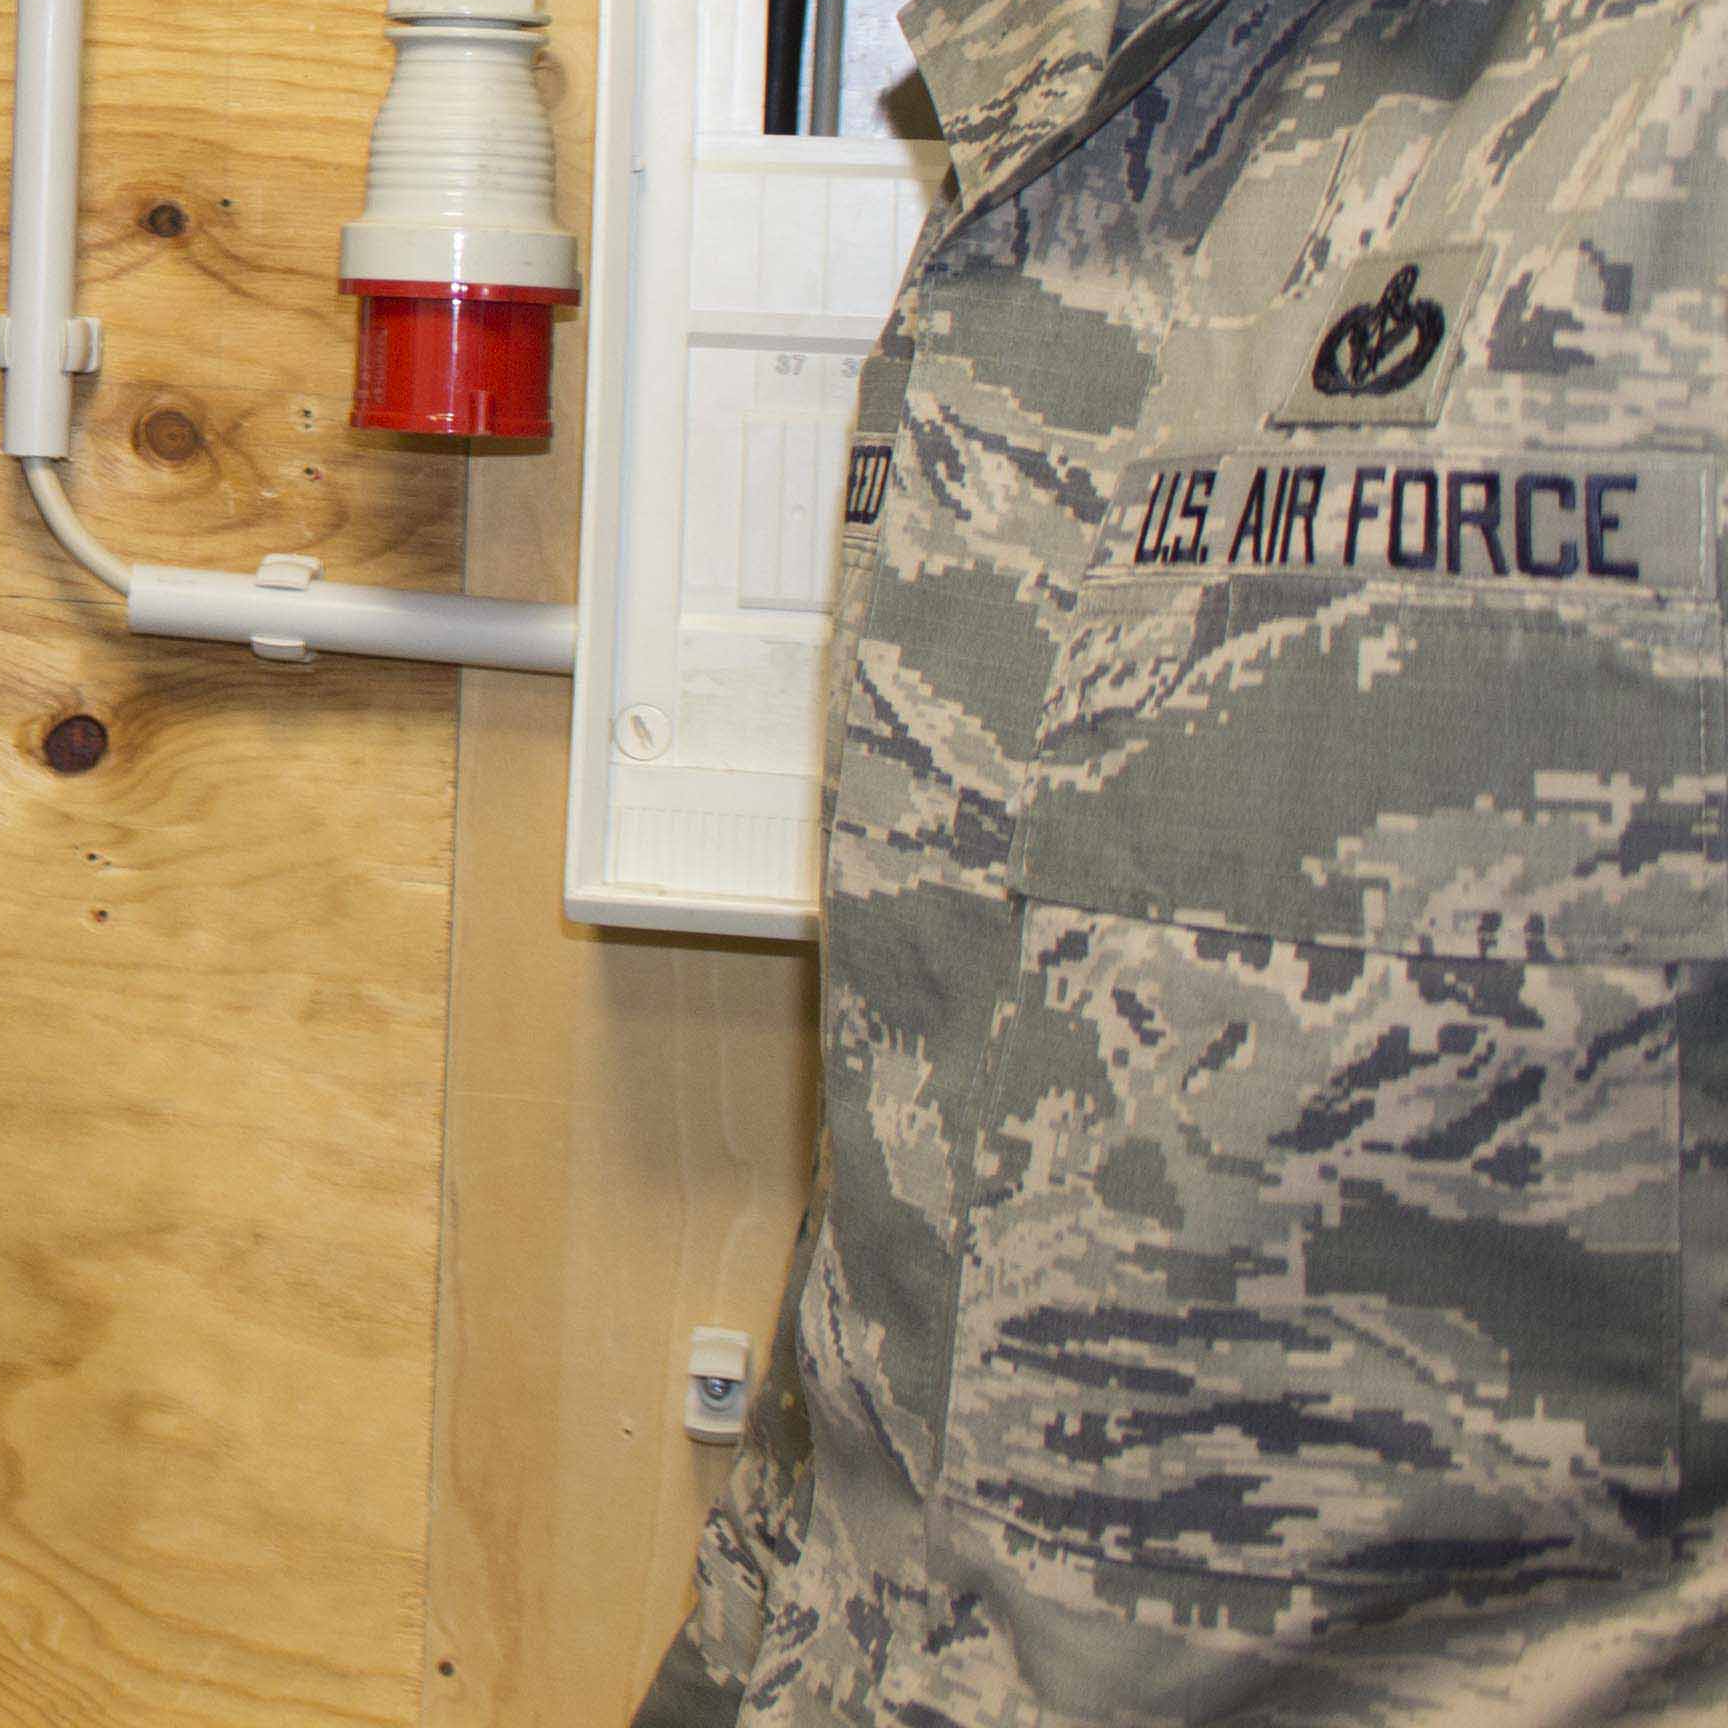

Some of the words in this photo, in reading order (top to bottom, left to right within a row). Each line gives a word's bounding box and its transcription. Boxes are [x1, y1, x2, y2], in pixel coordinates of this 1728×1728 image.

[846, 445, 892, 525] EED
[1134, 471, 1218, 565] U.S.
[1228, 467, 1326, 565] AIR
[1344, 467, 1640, 579] FORCE
